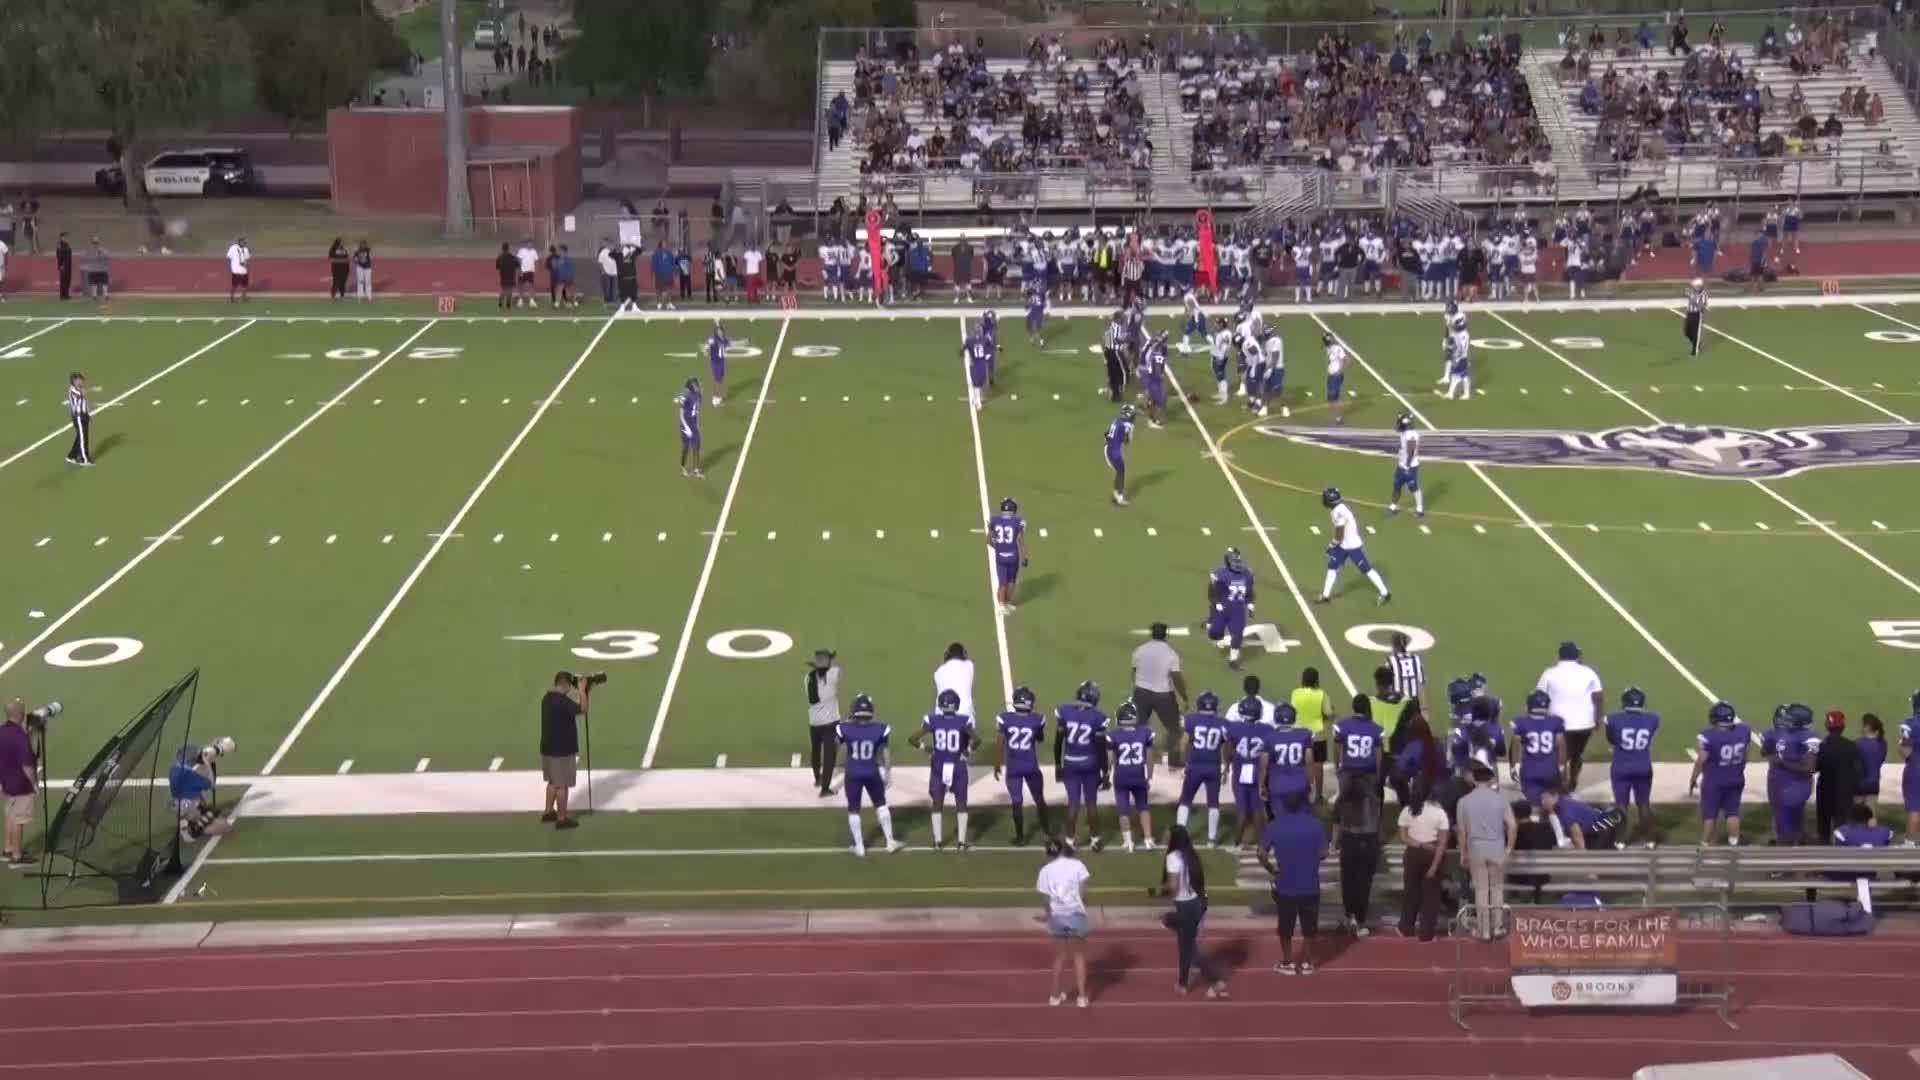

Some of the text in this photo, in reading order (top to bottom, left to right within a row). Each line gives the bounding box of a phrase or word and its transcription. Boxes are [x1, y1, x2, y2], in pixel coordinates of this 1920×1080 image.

[995, 525, 1014, 544] 33
[935, 729, 960, 752] 80
[1008, 727, 1033, 750] 22
[1066, 721, 1093, 745] 72
[1193, 726, 1220, 750] 50
[1526, 731, 1553, 754] 39
[1621, 728, 1649, 751] 56
[851, 740, 874, 760] 10
[1119, 743, 1144, 766] 23
[1237, 737, 1263, 758] 42
[1275, 743, 1302, 765] 70
[1347, 735, 1374, 758] 58
[1719, 743, 1745, 766] 95
[1515, 916, 1671, 932] BRACES FOR THE
[1521, 934, 1665, 949] WHOLE FAMILY!
